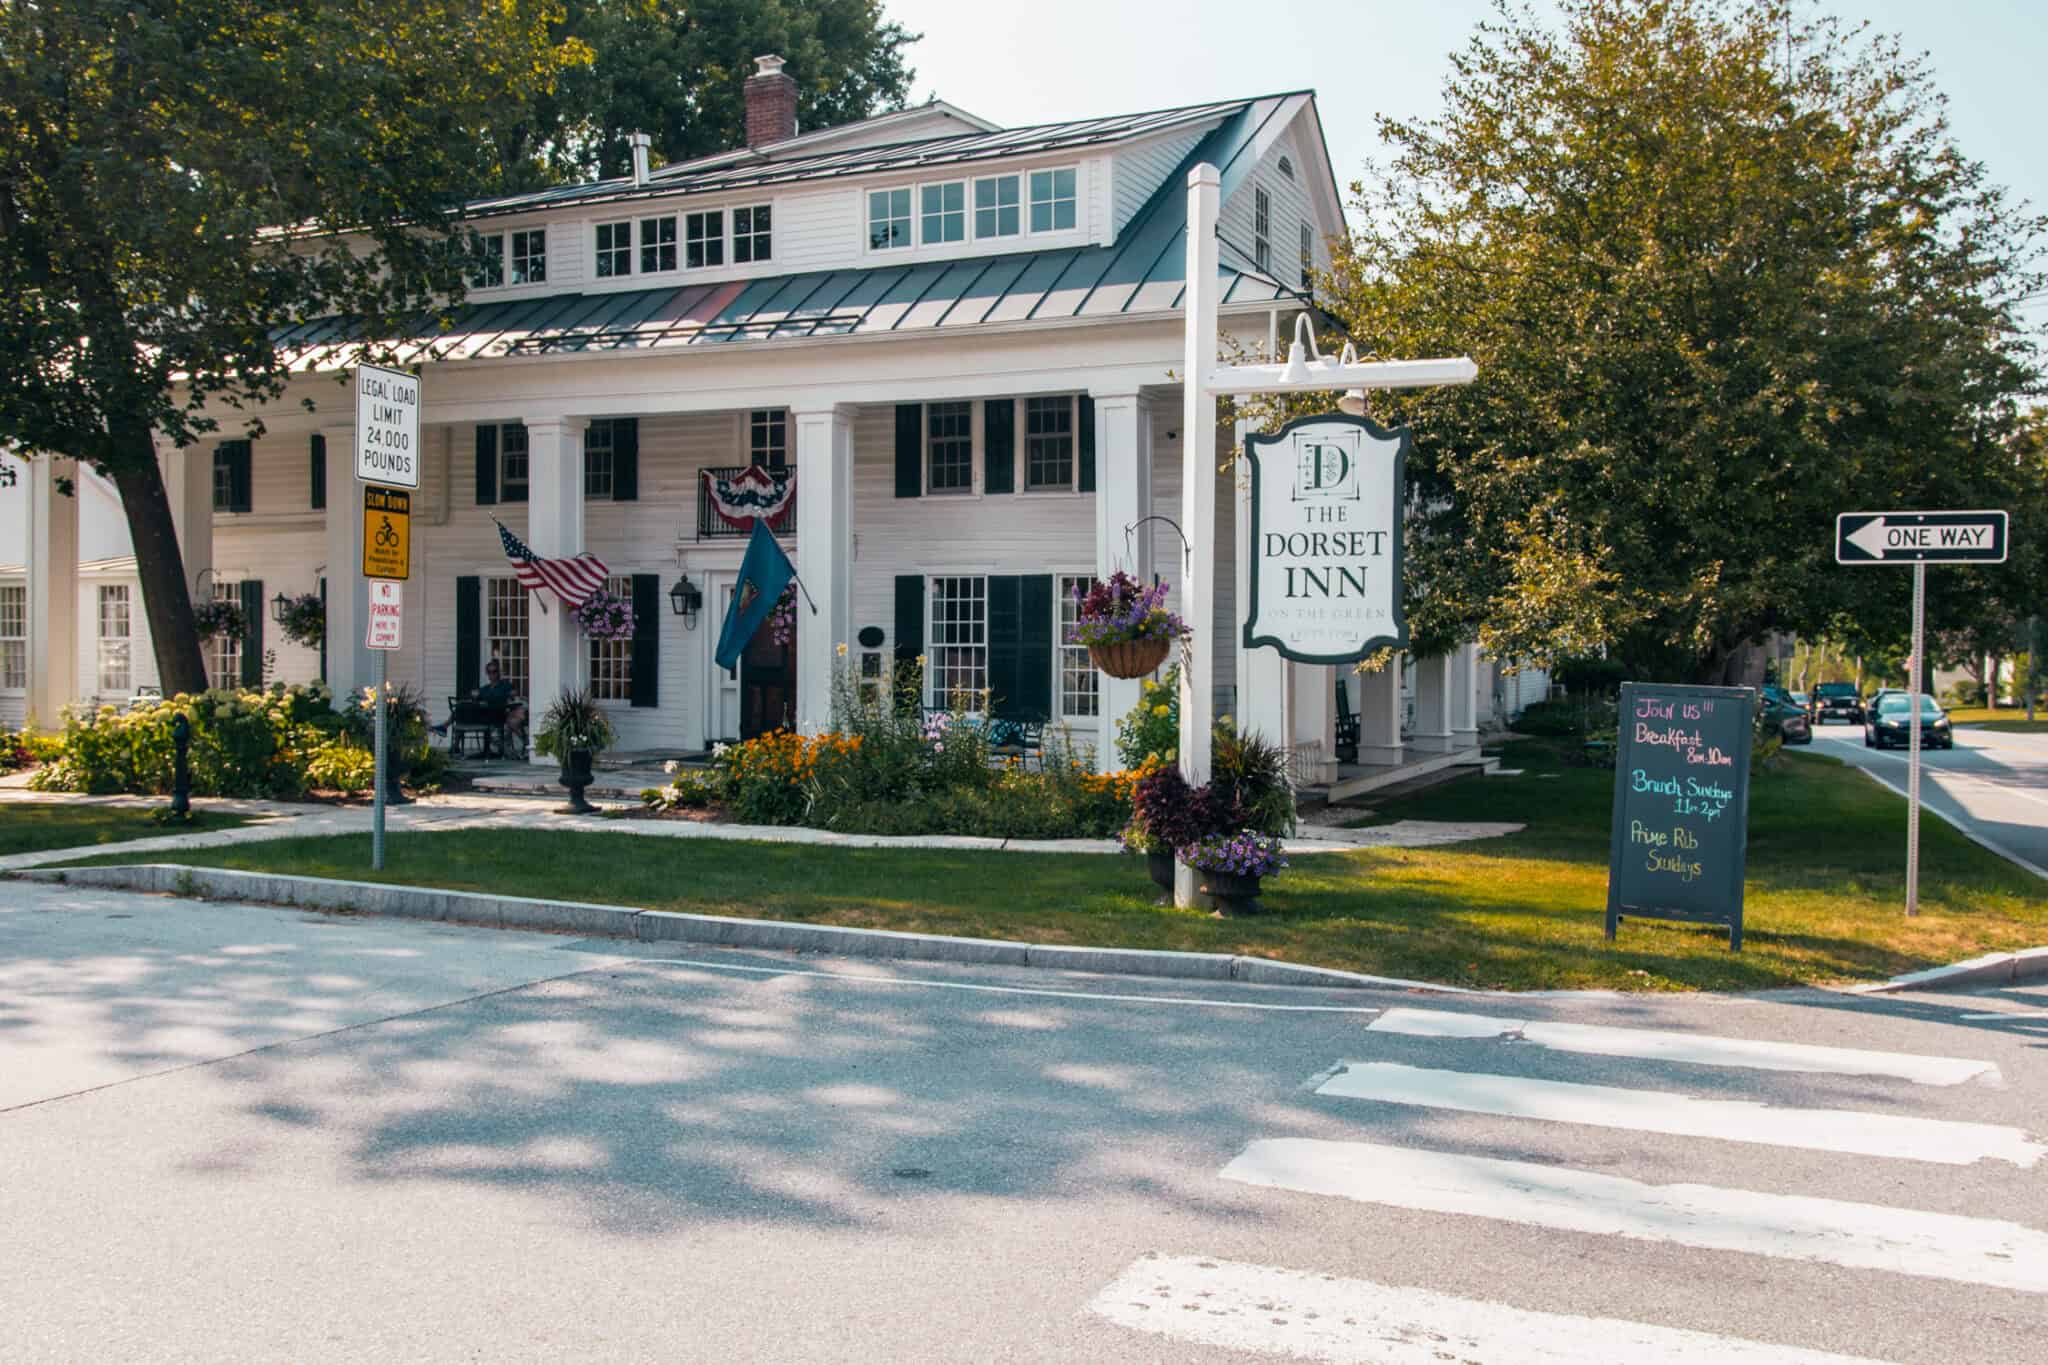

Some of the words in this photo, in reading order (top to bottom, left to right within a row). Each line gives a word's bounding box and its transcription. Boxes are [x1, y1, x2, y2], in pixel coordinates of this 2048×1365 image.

[361, 377, 388, 400] LEGAL
[393, 385, 416, 406] LOAD
[373, 404, 403, 425] LIMIT
[367, 426, 409, 450] 24,000
[364, 449, 412, 473] POUNDS
[387, 495, 408, 510] DOWN
[1304, 506, 1347, 523] THE
[1265, 530, 1388, 557] DORSET
[1887, 528, 1931, 547] ONE
[1939, 527, 1986, 546] WAY
[1284, 566, 1368, 598] INN
[371, 602, 400, 617] PARKING
[1267, 608, 1289, 618] ON
[1296, 608, 1327, 619] THE
[1333, 607, 1385, 619] GREEN
[1635, 722, 1703, 752] Breakfast
[1632, 769, 1682, 797] Brunch
[1687, 777, 1733, 808] Sundays
[1631, 820, 1667, 846] Prime
[1674, 827, 1699, 849] Rib
[1647, 848, 1702, 882] Sundays
